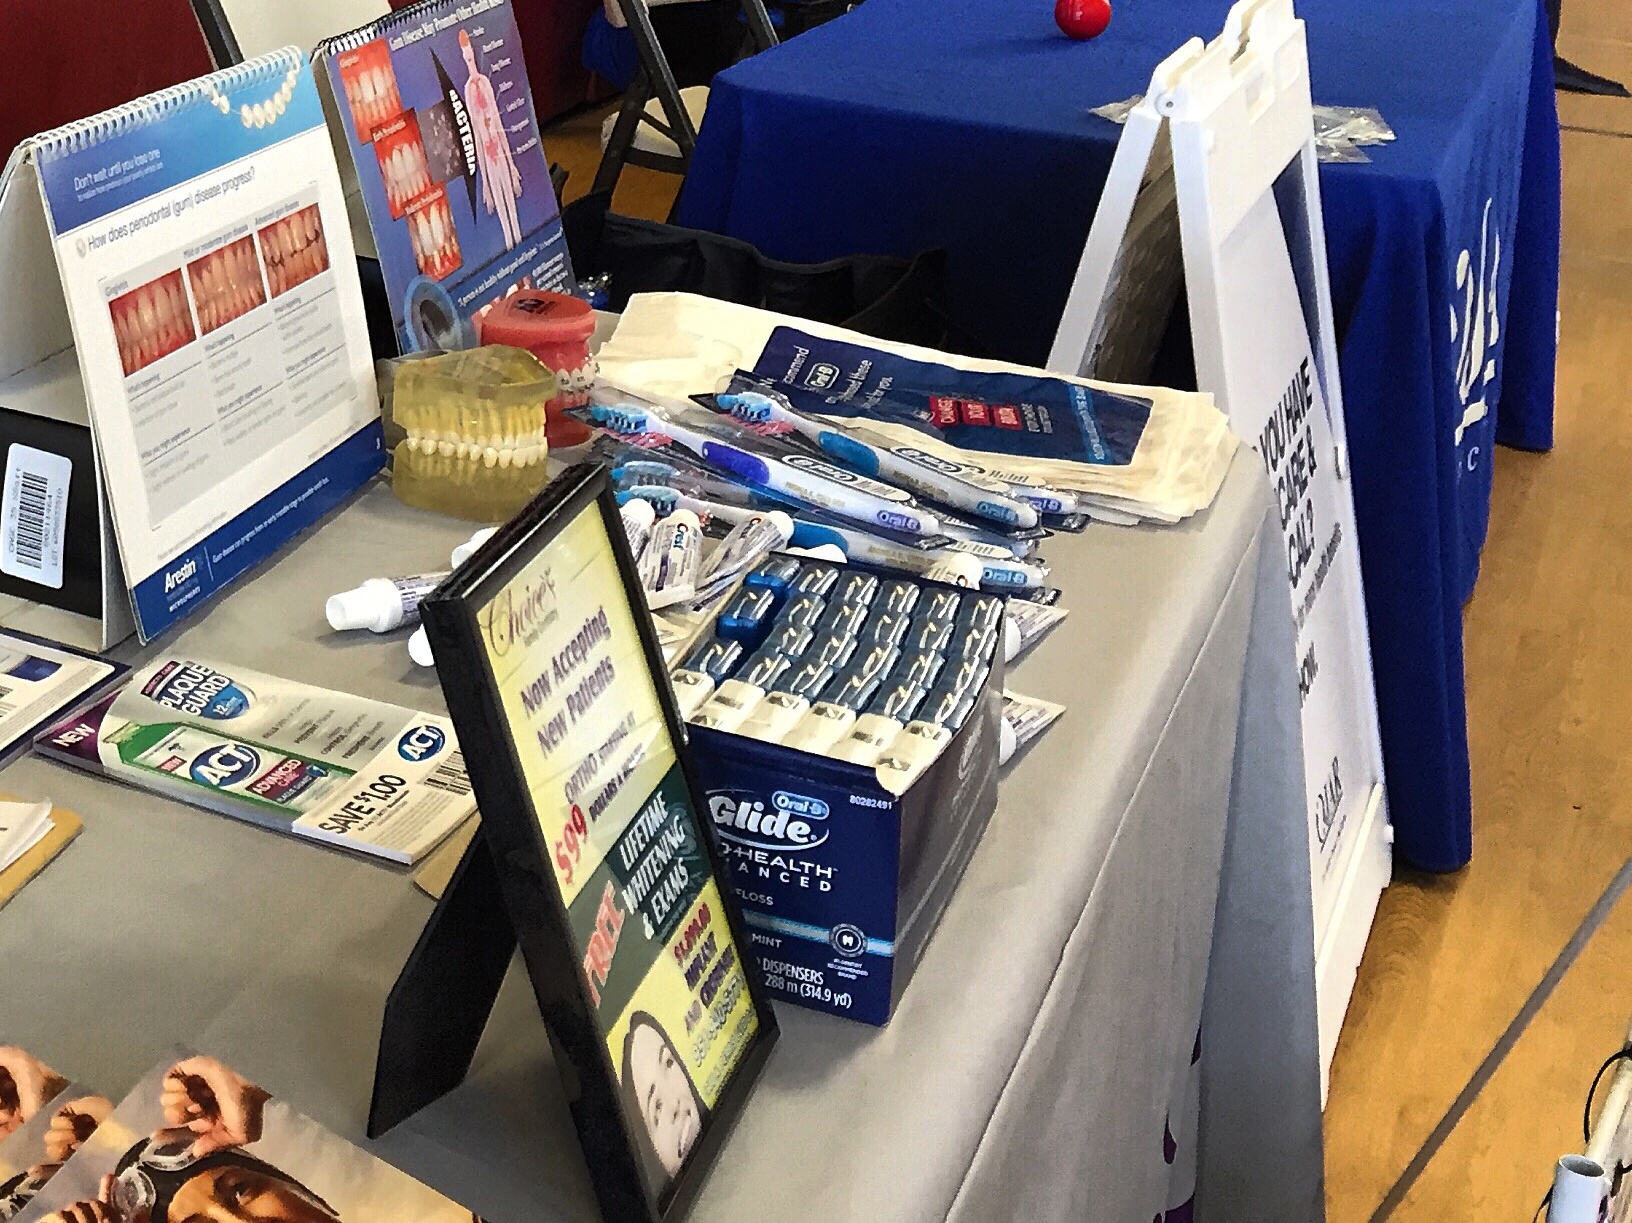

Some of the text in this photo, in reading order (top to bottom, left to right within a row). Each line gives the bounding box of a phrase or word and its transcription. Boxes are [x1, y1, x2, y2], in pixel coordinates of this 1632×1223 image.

[448, 89, 476, 176] BACTERIA
[74, 169, 93, 192] Don't
[107, 160, 123, 178] until
[121, 157, 135, 178] you
[147, 148, 161, 164] one
[87, 230, 109, 253] How
[108, 220, 129, 244] does
[129, 202, 172, 239] periodontal
[172, 194, 195, 220] (gum)
[194, 181, 222, 206] disease
[221, 165, 257, 198] progress?
[810, 365, 834, 388] Oral-B
[1259, 355, 1314, 479] YOU HAVE
[376, 436, 382, 451] 3
[1305, 423, 1318, 478] &
[164, 558, 198, 594] Arestin
[480, 577, 552, 658] Choice
[520, 604, 612, 721] Now Accepting
[159, 664, 214, 711] PLAQUE
[181, 675, 231, 717] GUARD
[537, 654, 616, 760] New Patients
[51, 722, 96, 748] NEW
[401, 725, 441, 761] ACT
[196, 743, 255, 787] ACT
[251, 758, 303, 796] ADVANCED
[564, 751, 599, 806] ORTHO
[318, 800, 376, 835] SAVE
[352, 774, 408, 807] $1.00
[589, 777, 619, 823] DOLLARS
[708, 795, 811, 844] Glide
[776, 795, 827, 816] Oral-B
[555, 802, 589, 886] $99
[619, 789, 669, 872] LIFETIME
[621, 814, 687, 916] WHITENING
[642, 857, 690, 941] & EXAMS
[752, 933, 783, 949] MINT
[763, 957, 825, 985] DISPENSERS
[786, 981, 799, 994] m
[800, 982, 833, 1003] (314.9
[833, 991, 853, 1010] yd)
